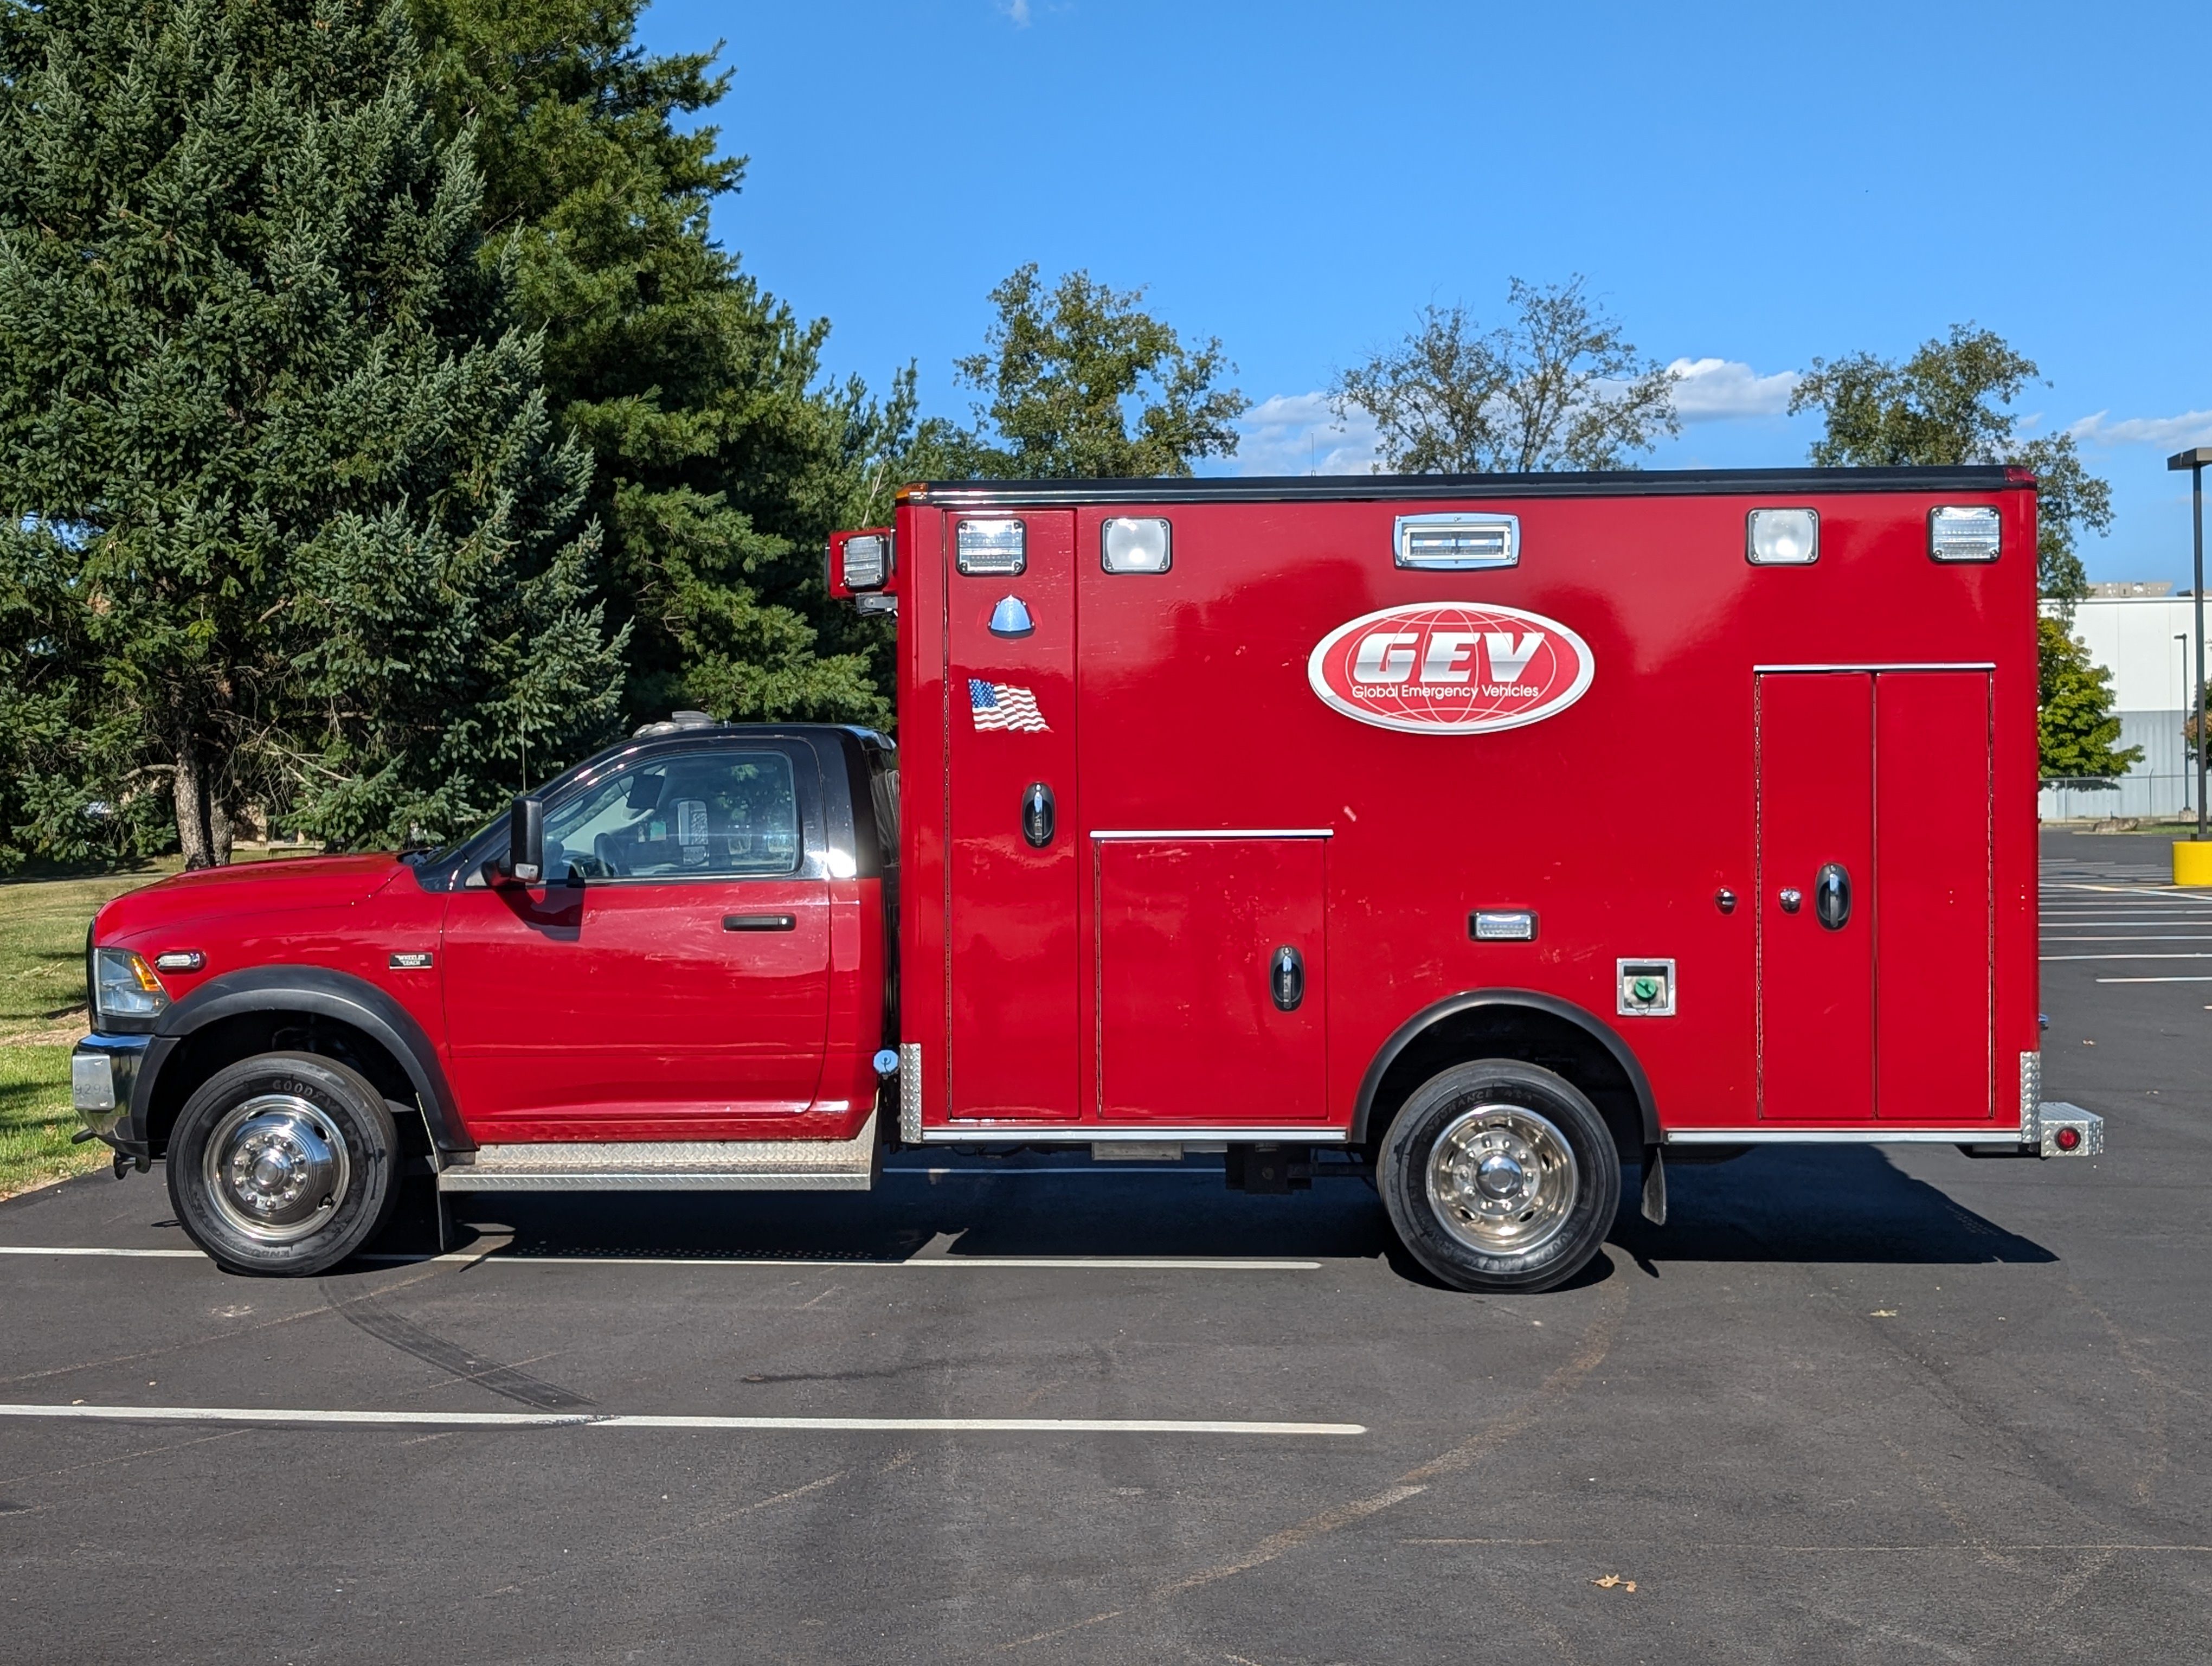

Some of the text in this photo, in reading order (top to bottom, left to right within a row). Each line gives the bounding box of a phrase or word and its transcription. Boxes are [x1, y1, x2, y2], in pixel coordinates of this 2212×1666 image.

[1353, 632, 1545, 683] GEV
[1352, 683, 1539, 700] Global Emergency Vehicles
[74, 1084, 111, 1095] 9294
